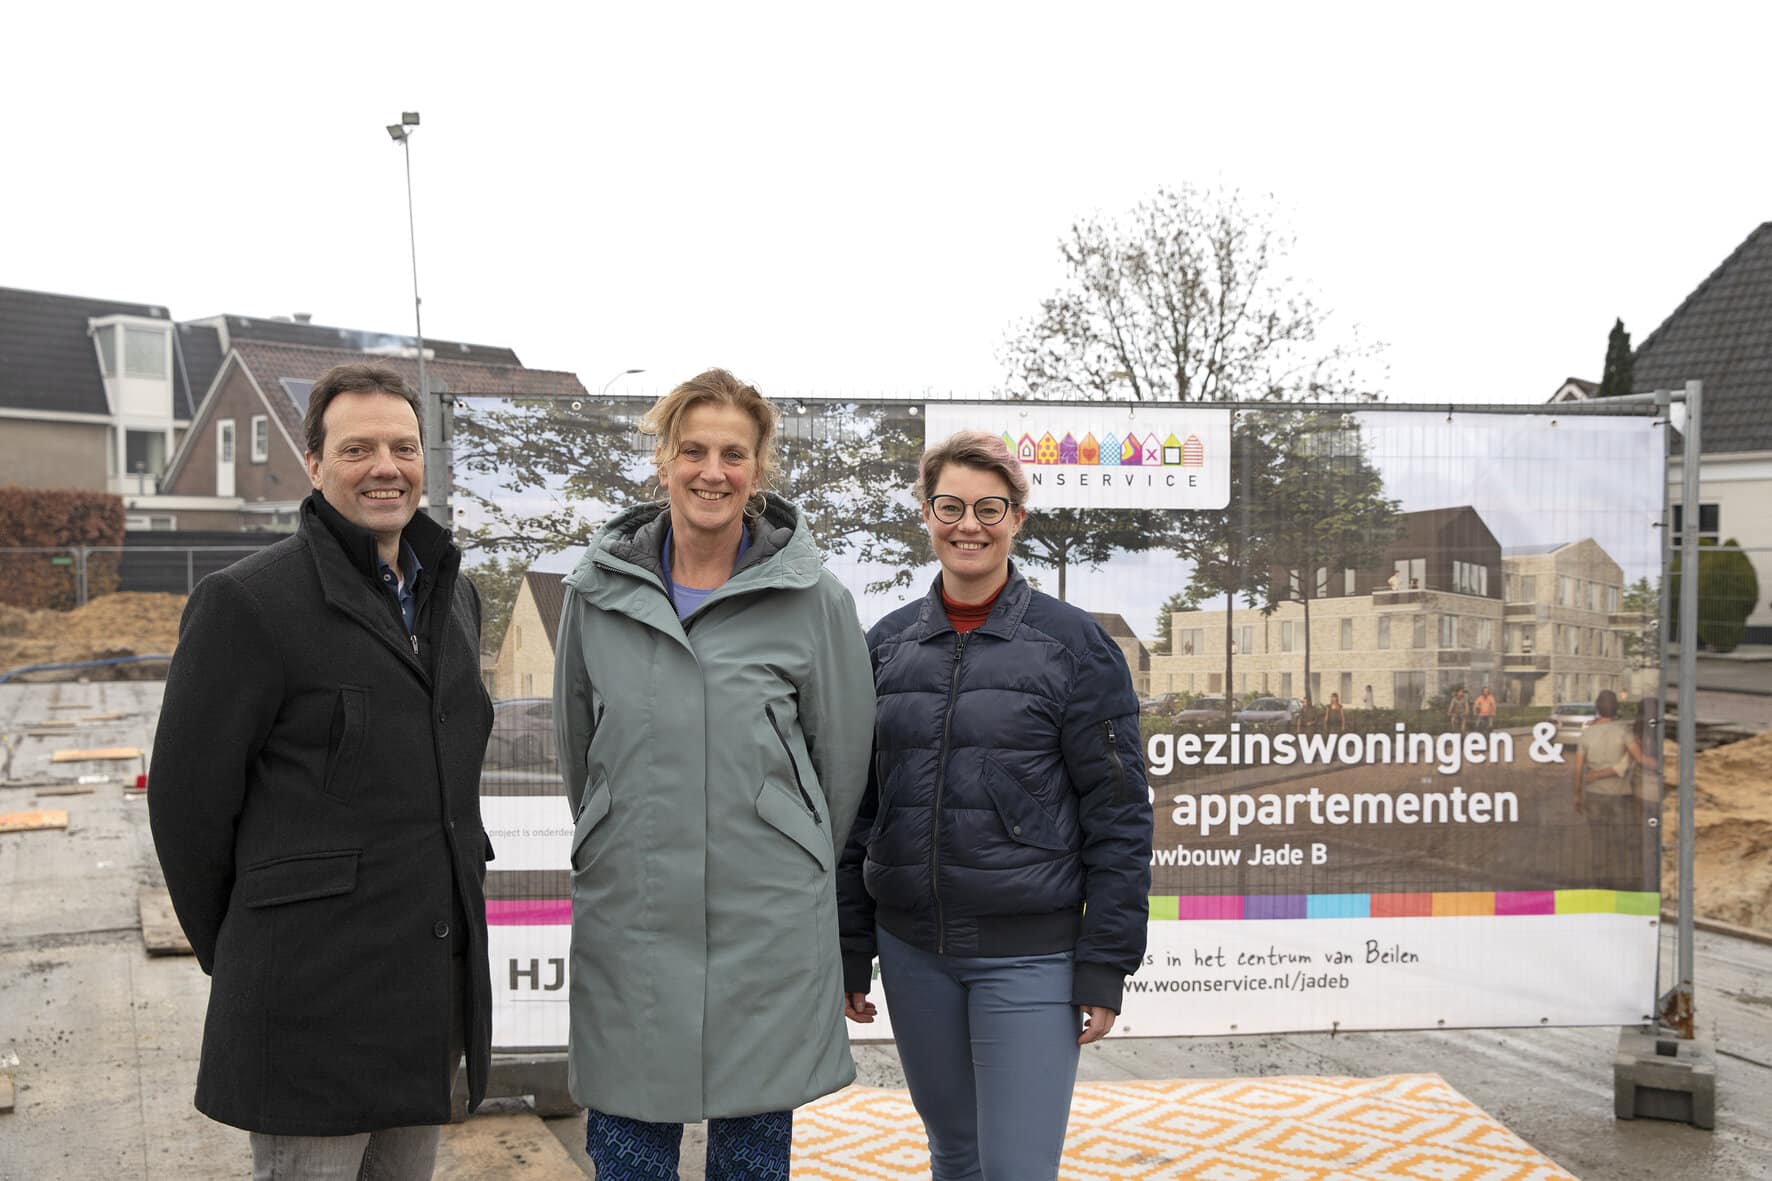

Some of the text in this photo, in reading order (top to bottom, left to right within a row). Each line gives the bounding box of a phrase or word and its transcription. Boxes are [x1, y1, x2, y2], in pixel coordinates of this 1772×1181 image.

[1032, 473, 1198, 487] NSERVICE
[1147, 721, 1566, 776] gezinswoningen &
[1171, 786, 1519, 836] appartementen
[488, 828, 520, 839] project
[522, 827, 531, 837] is
[1247, 843, 1304, 866] Jade
[1311, 843, 1328, 865] B
[1167, 951, 1182, 967] in
[1194, 946, 1226, 967] het
[1237, 945, 1312, 967] centrum
[1325, 951, 1353, 965] van
[1365, 939, 1420, 965] Beilen
[509, 958, 565, 991] HJ
